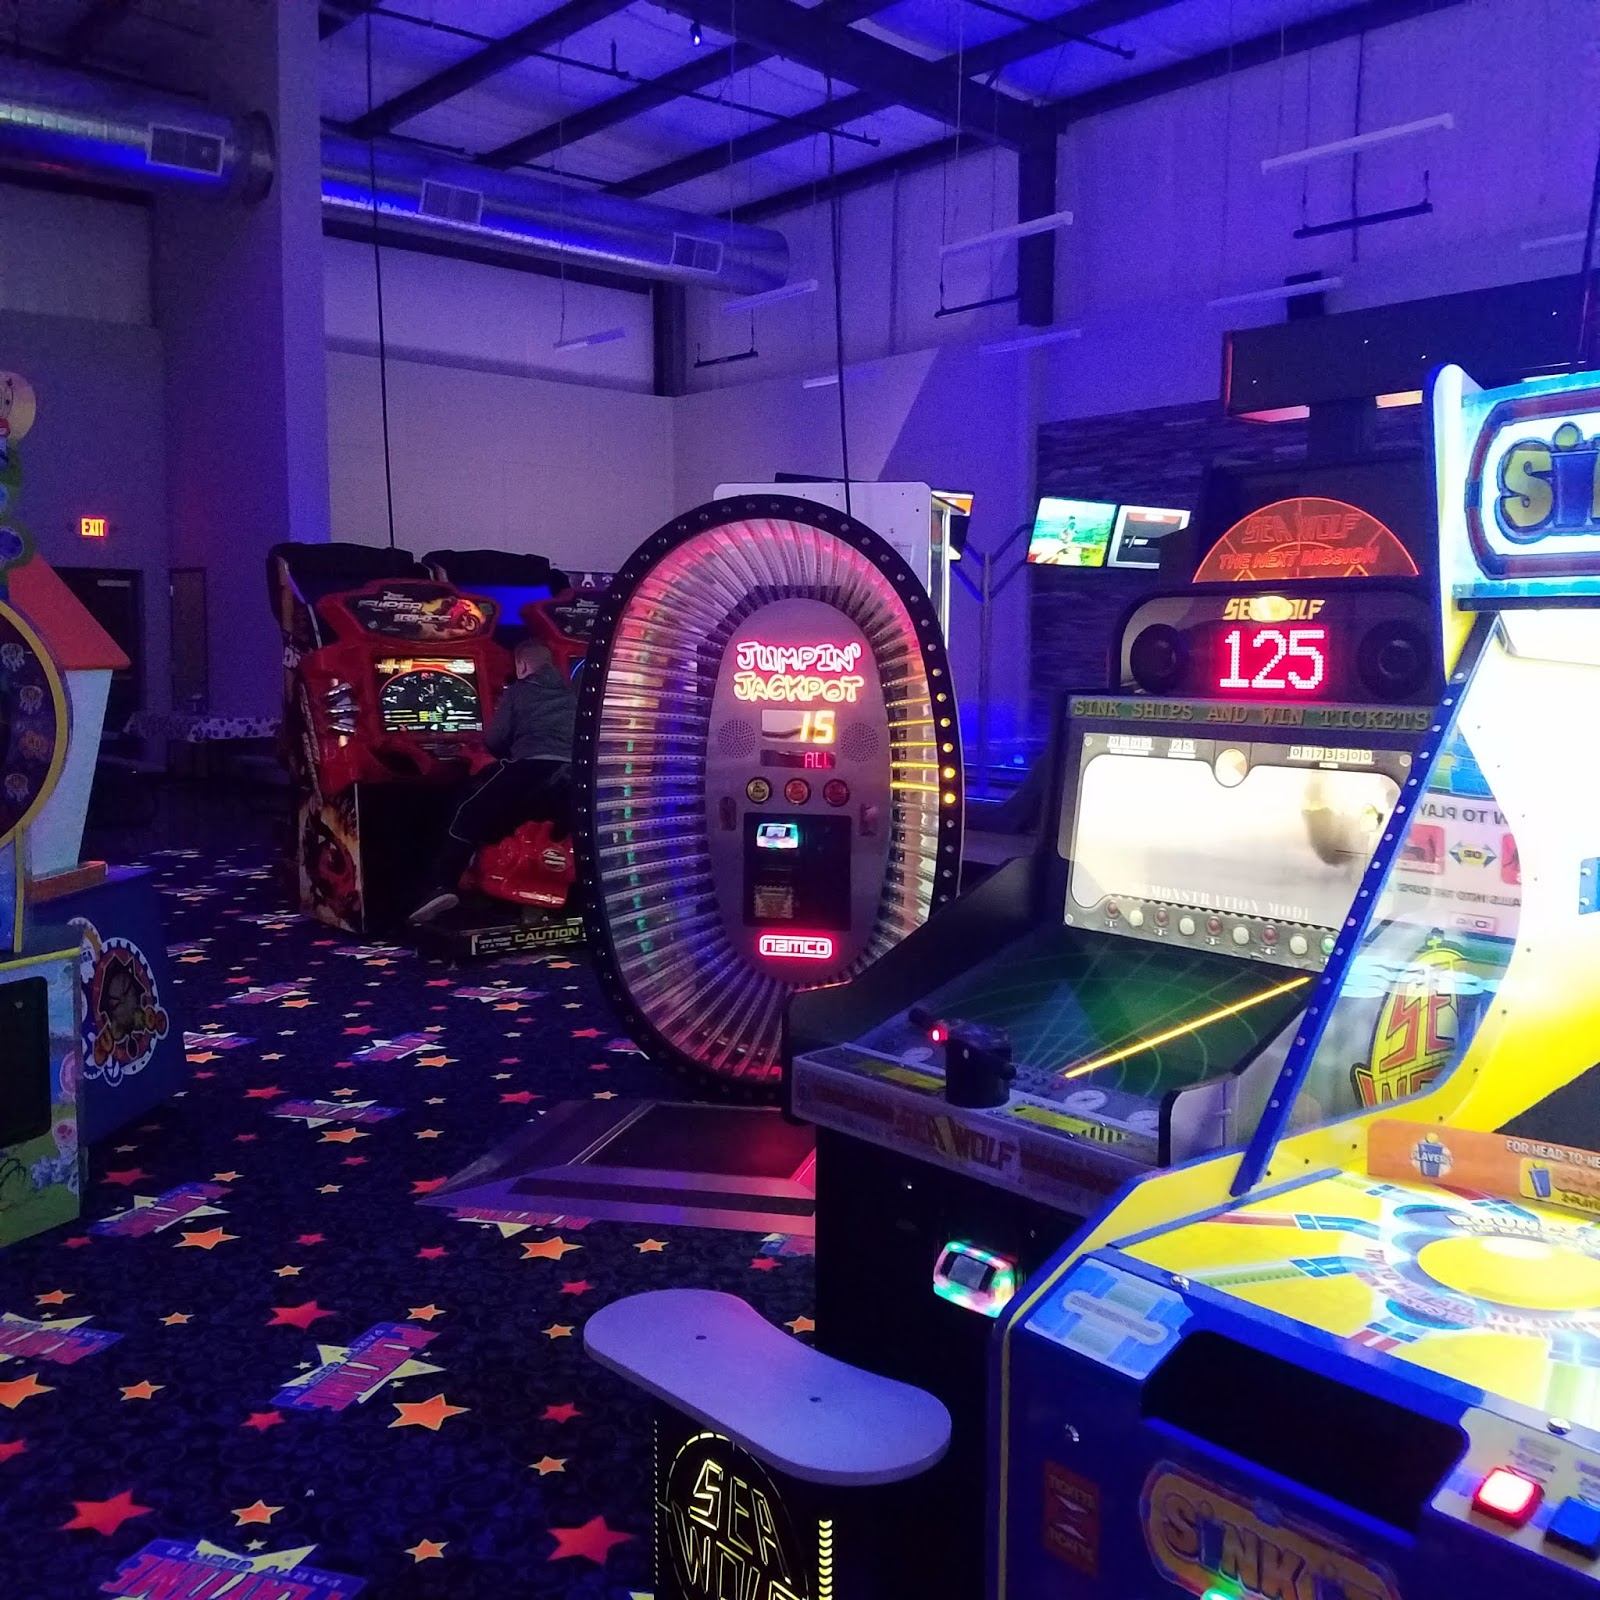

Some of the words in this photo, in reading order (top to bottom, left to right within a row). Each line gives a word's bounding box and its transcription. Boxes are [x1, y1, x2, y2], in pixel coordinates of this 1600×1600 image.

[81, 518, 105, 536] EXIT
[1241, 516, 1293, 543] SEA
[1296, 513, 1362, 541] WOLF
[1219, 554, 1252, 570] THE
[1253, 551, 1299, 569] NEXT
[1301, 547, 1380, 566] MISSION
[1219, 629, 1325, 689] 125
[733, 672, 864, 702] JACKPOT
[801, 710, 836, 744] 15
[1073, 699, 1121, 718] SINK
[1132, 702, 1194, 720] SHIPS
[1206, 705, 1250, 723] AND
[1260, 707, 1306, 726] WIN
[1319, 709, 1431, 731] TICKETS
[1149, 884, 1260, 913] MONSTRATION
[515, 927, 580, 943] CAUTION
[763, 939, 829, 955] namco
[1506, 1140, 1530, 1155] FOR
[688, 1458, 791, 1585] SEA
